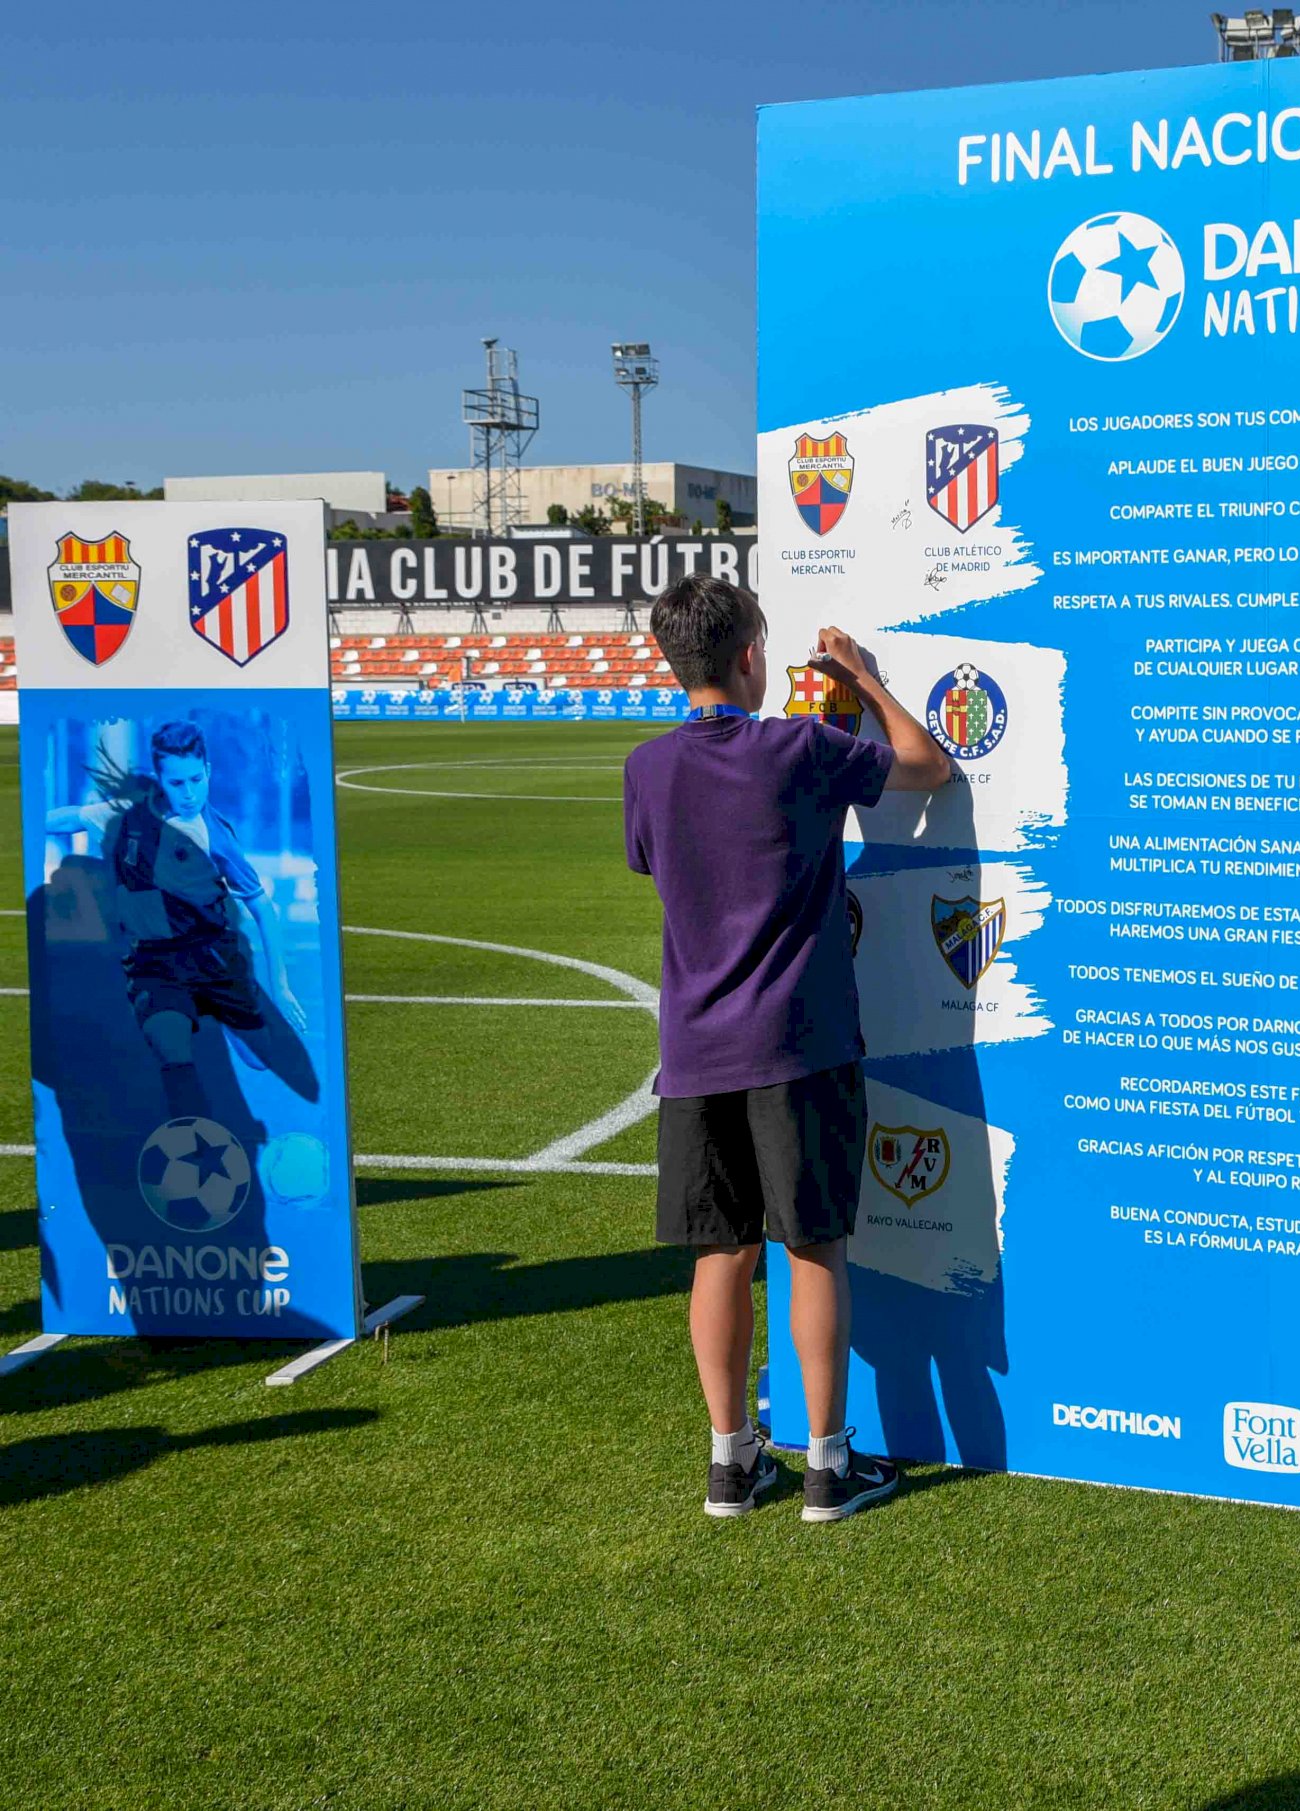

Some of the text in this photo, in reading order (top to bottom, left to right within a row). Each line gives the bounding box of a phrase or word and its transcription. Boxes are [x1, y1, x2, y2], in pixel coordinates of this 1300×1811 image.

[957, 125, 1113, 185] FINAL
[1070, 417, 1098, 432] LOS
[1102, 413, 1194, 431] JUGADORES
[1198, 412, 1231, 428] SON
[1235, 411, 1266, 426] TUS
[781, 549, 856, 561] CLUB ESPORTIU
[925, 543, 1002, 557] CLUB ATLÉTICO
[1053, 551, 1072, 566] ES
[1075, 549, 1169, 565] IMPORTANTE
[1173, 548, 1231, 564] GANAR,
[1234, 547, 1275, 562] PERO
[1279, 546, 1299, 562] LO
[390, 545, 518, 599] CLUB
[535, 544, 595, 598] DE
[791, 564, 846, 575] MERCANTIL
[936, 562, 991, 573] DE MADRID
[1053, 595, 1117, 609] RESPETA
[1121, 595, 1131, 608] A
[1135, 594, 1165, 608] TUS
[1169, 593, 1232, 608] RIVALES.
[1237, 592, 1299, 608] CUMPLE
[1131, 706, 1198, 720] COMPITE
[1202, 706, 1227, 720] SIN
[928, 710, 957, 754] GETAFE
[949, 773, 991, 783] TAFE CF
[1110, 836, 1140, 849] UNA
[1144, 836, 1256, 853] ALIMENTACIÓN
[1056, 898, 1107, 915] TODOS
[1111, 901, 1236, 920] DISFRUTAREMOS
[1240, 906, 1260, 921] DE
[941, 1000, 999, 1012] MALAGA CF
[1063, 1030, 1081, 1044] DE
[1086, 1032, 1135, 1047] HACER
[1139, 1034, 1158, 1049] LO
[1162, 1035, 1193, 1051] QUE
[1197, 1035, 1231, 1052] MÁS
[1235, 1040, 1268, 1054] NOS
[1064, 1094, 1110, 1111] COMO
[1115, 1099, 1146, 1113] UNA
[1150, 1100, 1200, 1116] FIESTA
[1204, 1104, 1232, 1119] DEL
[1236, 1104, 1296, 1123] FÚTBOL
[867, 1215, 953, 1232] RAYO VALLECANO
[1111, 1206, 1160, 1222] BUENA
[1164, 1210, 1252, 1231] CONDUCTA,
[107, 1243, 290, 1282] DANONE
[109, 1286, 291, 1318] NATIONS CUP
[1052, 1402, 1181, 1440] DECATHLON
[1232, 1408, 1297, 1438] Font
[1232, 1437, 1299, 1467] Vella
